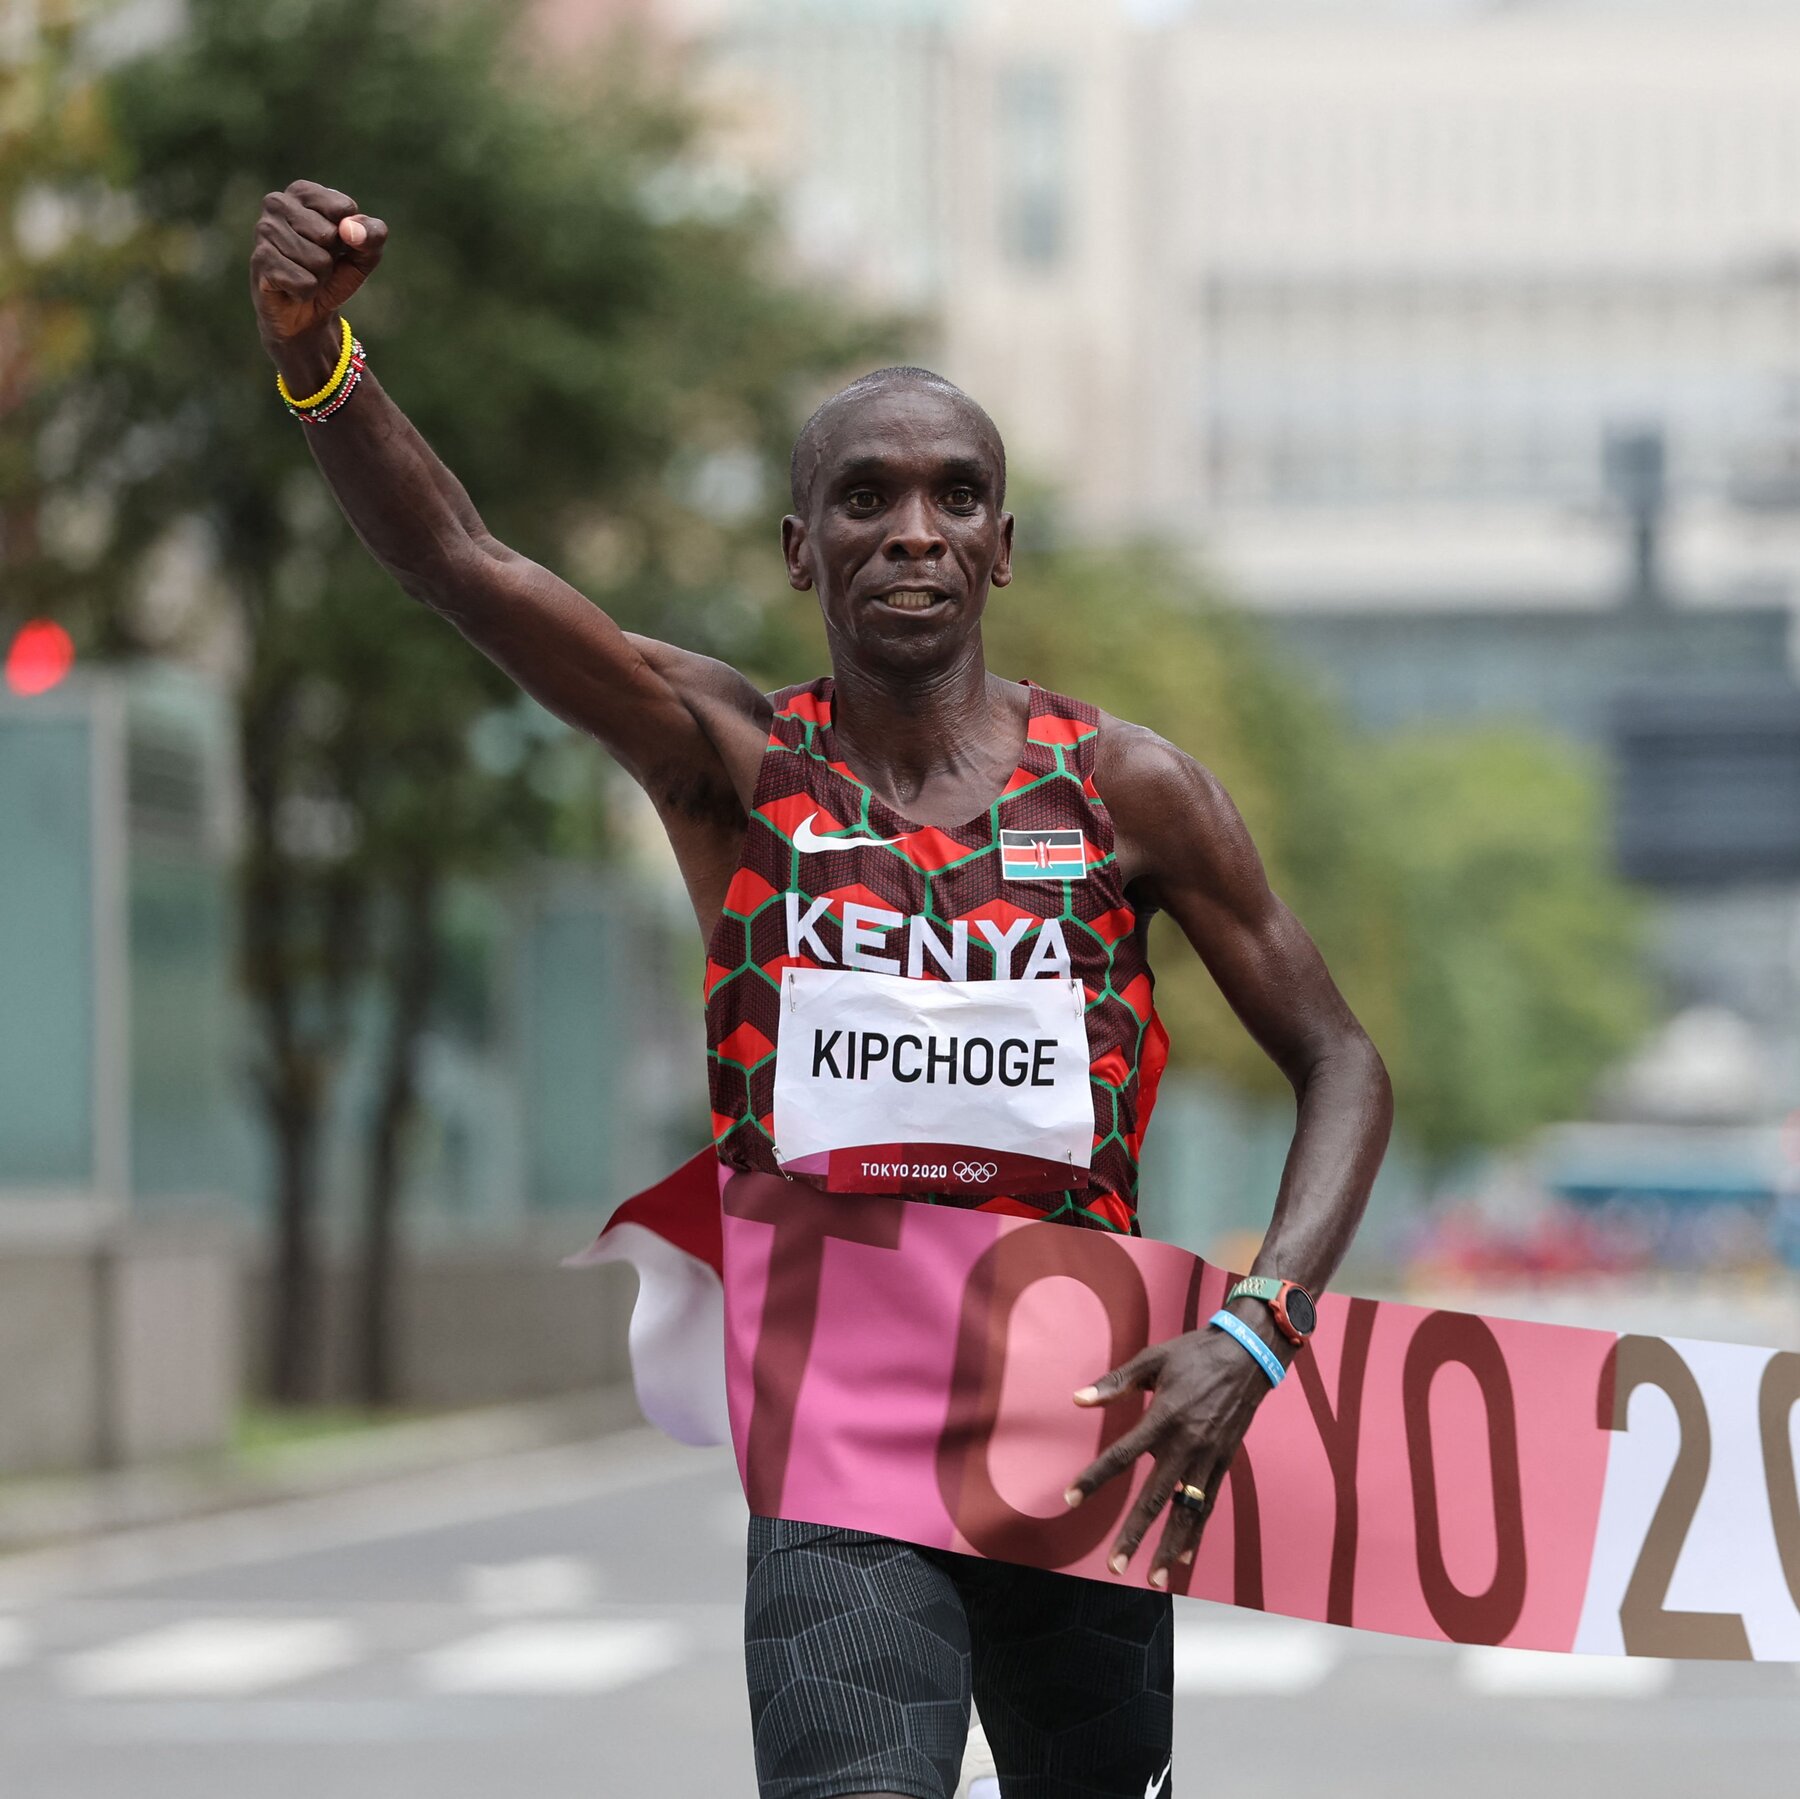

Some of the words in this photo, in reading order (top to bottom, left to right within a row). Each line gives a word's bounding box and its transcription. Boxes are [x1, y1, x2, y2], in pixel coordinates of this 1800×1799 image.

[785, 892, 1071, 982] KENYA
[811, 1029, 1059, 1087] KIPCHOGE
[861, 1162, 909, 1178] TOKYO
[912, 1164, 947, 1179] 2020
